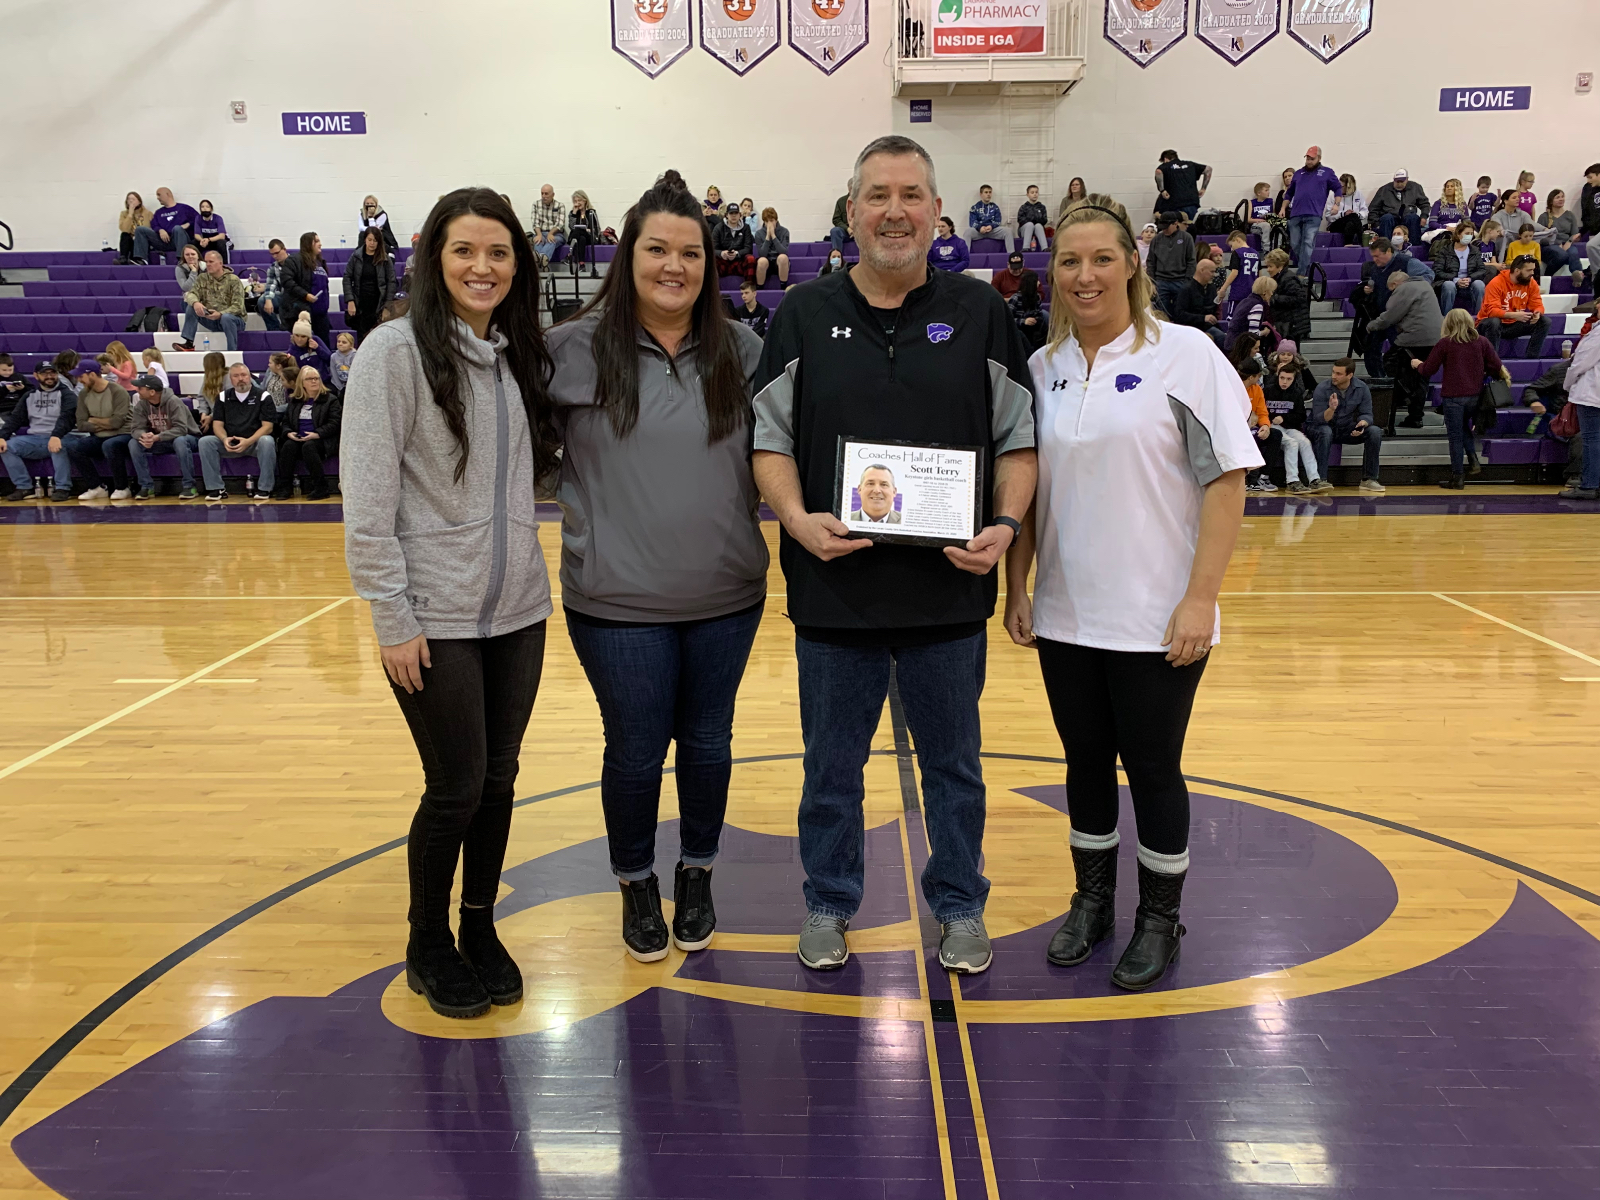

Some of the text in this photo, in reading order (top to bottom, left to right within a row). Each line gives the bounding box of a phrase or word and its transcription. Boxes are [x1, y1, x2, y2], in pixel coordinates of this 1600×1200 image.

[638, 0, 665, 13] 32
[727, 0, 753, 11] 31
[964, 5, 1041, 19] PHARMACY
[1111, 17, 1159, 30] GRADUATED
[1202, 13, 1274, 28] GRADUATED 2003
[1294, 12, 1344, 25] GRADUATED
[618, 28, 687, 41] GRADUATED 2004
[706, 26, 775, 39] GRADUATED 1978
[794, 24, 863, 37] GRADUATED 1978
[937, 34, 1015, 46] INSIDE IGA
[1455, 90, 1515, 108] HOME
[297, 115, 352, 132] HOME
[1243, 259, 1260, 276] 24
[857, 447, 963, 465] Coaches Hall of Fame
[910, 464, 961, 478] Scott Terry
